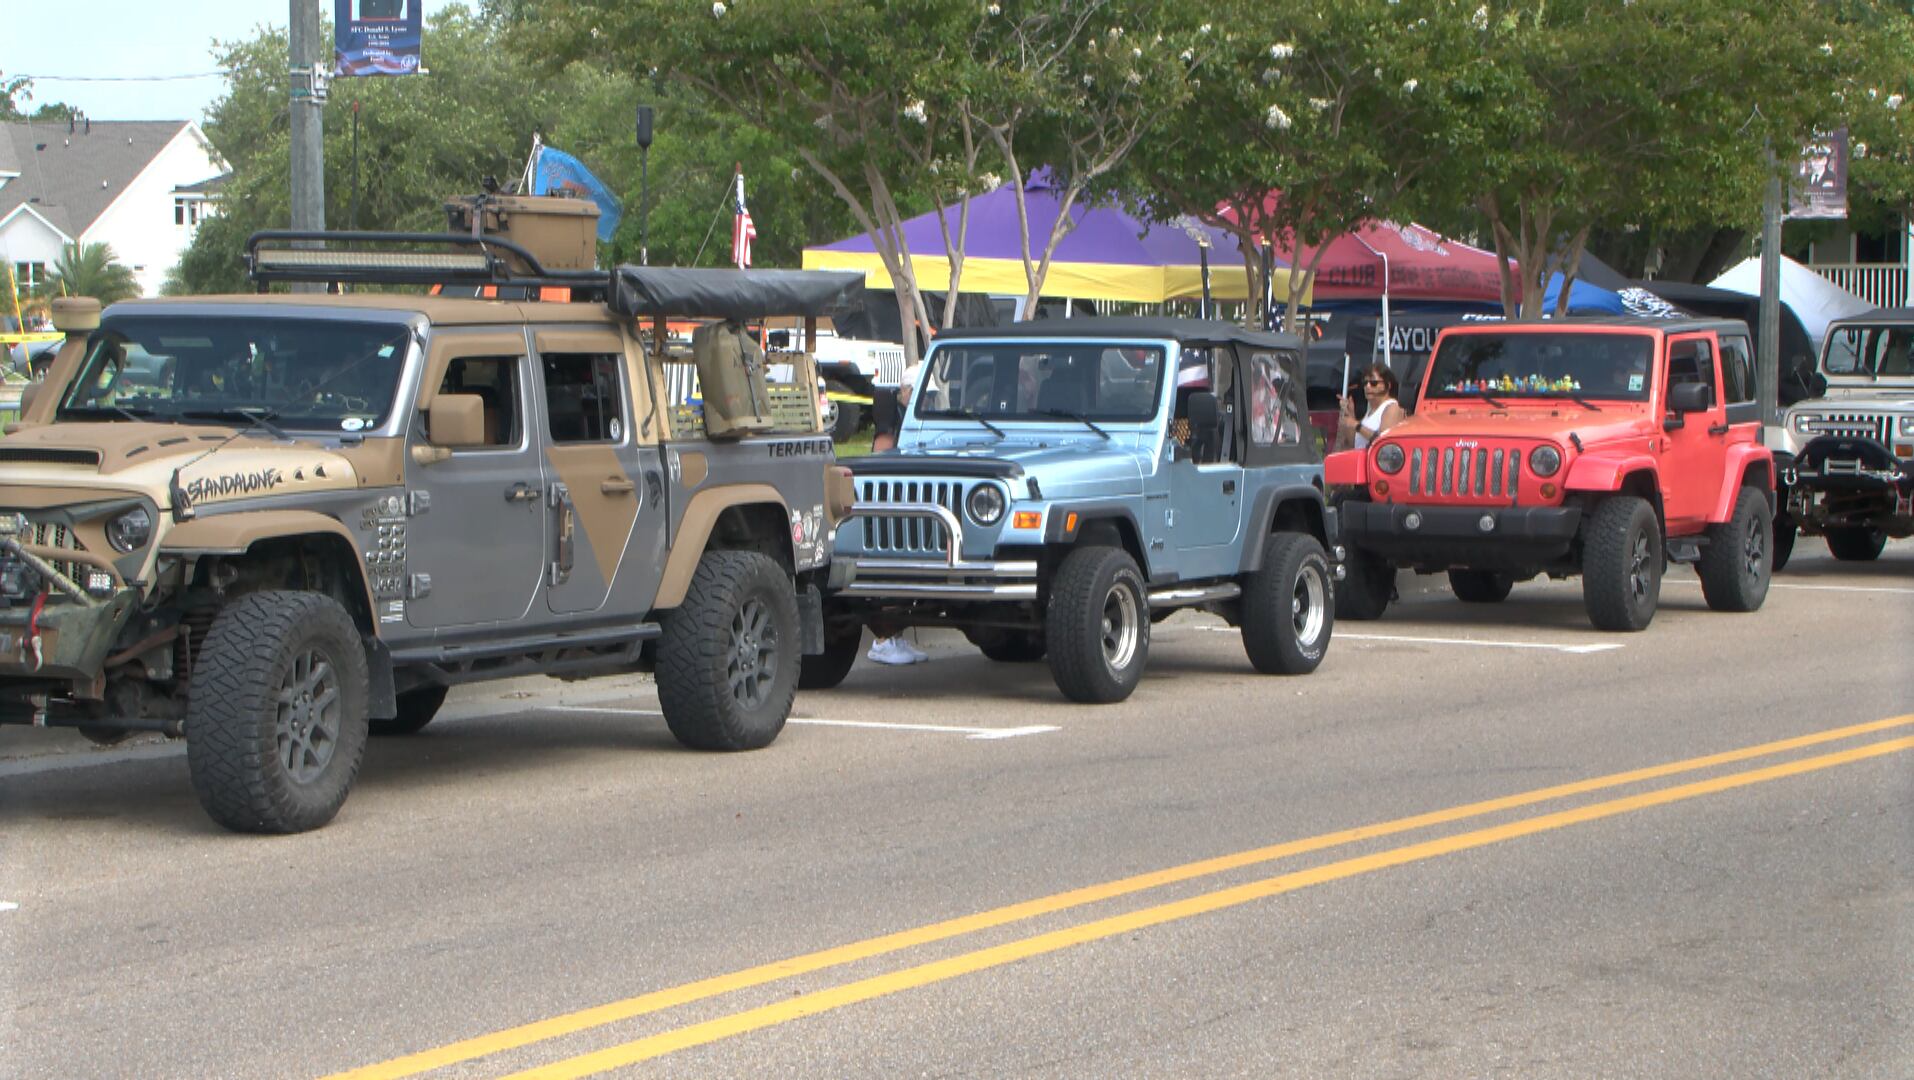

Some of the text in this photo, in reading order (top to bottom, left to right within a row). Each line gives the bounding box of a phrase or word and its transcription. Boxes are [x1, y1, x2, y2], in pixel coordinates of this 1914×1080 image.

[1328, 264, 1376, 287] CLUB
[768, 439, 833, 457] TERAFLEX
[1455, 438, 1478, 449] Jeep
[187, 468, 277, 501] STANDALONE
